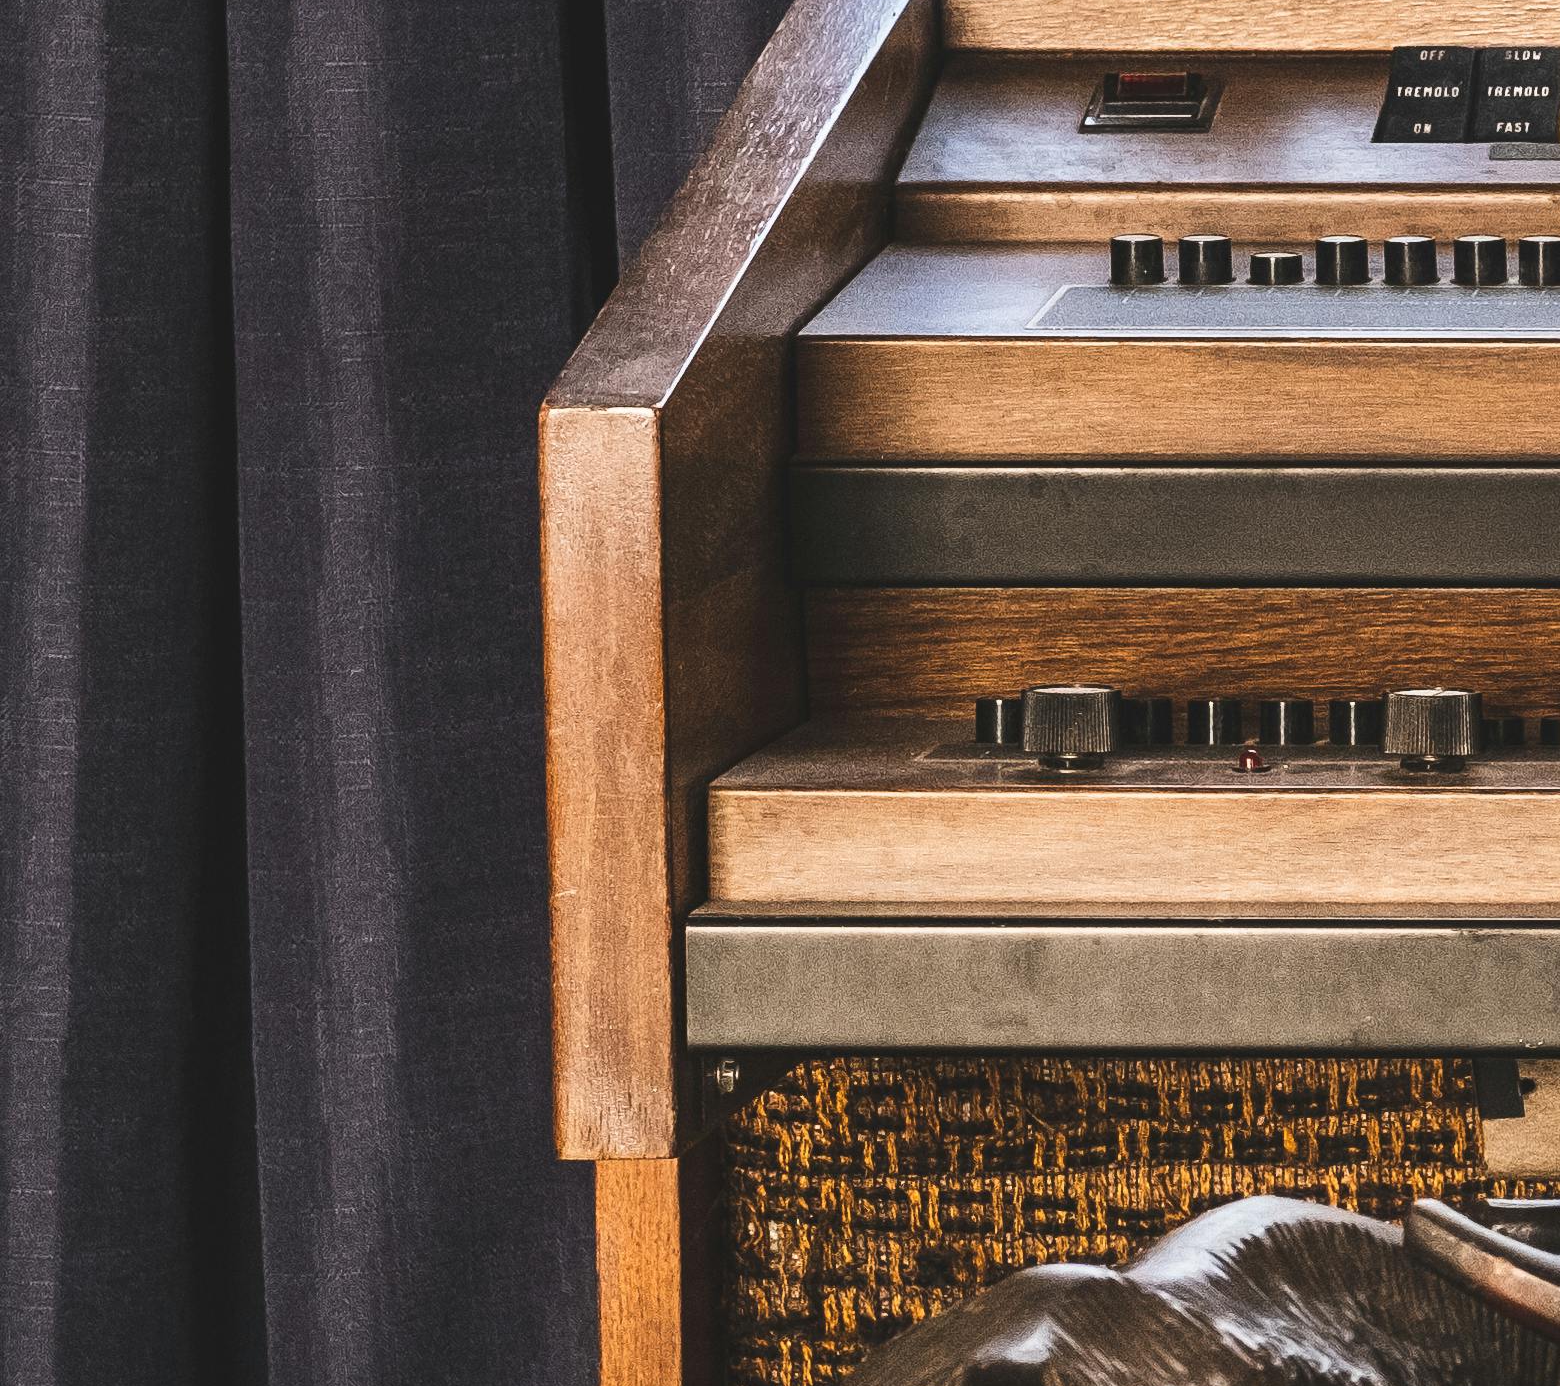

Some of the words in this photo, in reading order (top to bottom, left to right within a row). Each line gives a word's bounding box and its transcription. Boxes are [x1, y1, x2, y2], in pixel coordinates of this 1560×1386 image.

[1419, 50, 1446, 61] OFF
[1504, 50, 1542, 61] SLOW
[1396, 86, 1461, 98] TREMOLO
[1487, 86, 1550, 98] TREMOLO
[1413, 123, 1432, 134] ON
[1496, 122, 1531, 133] FAST
